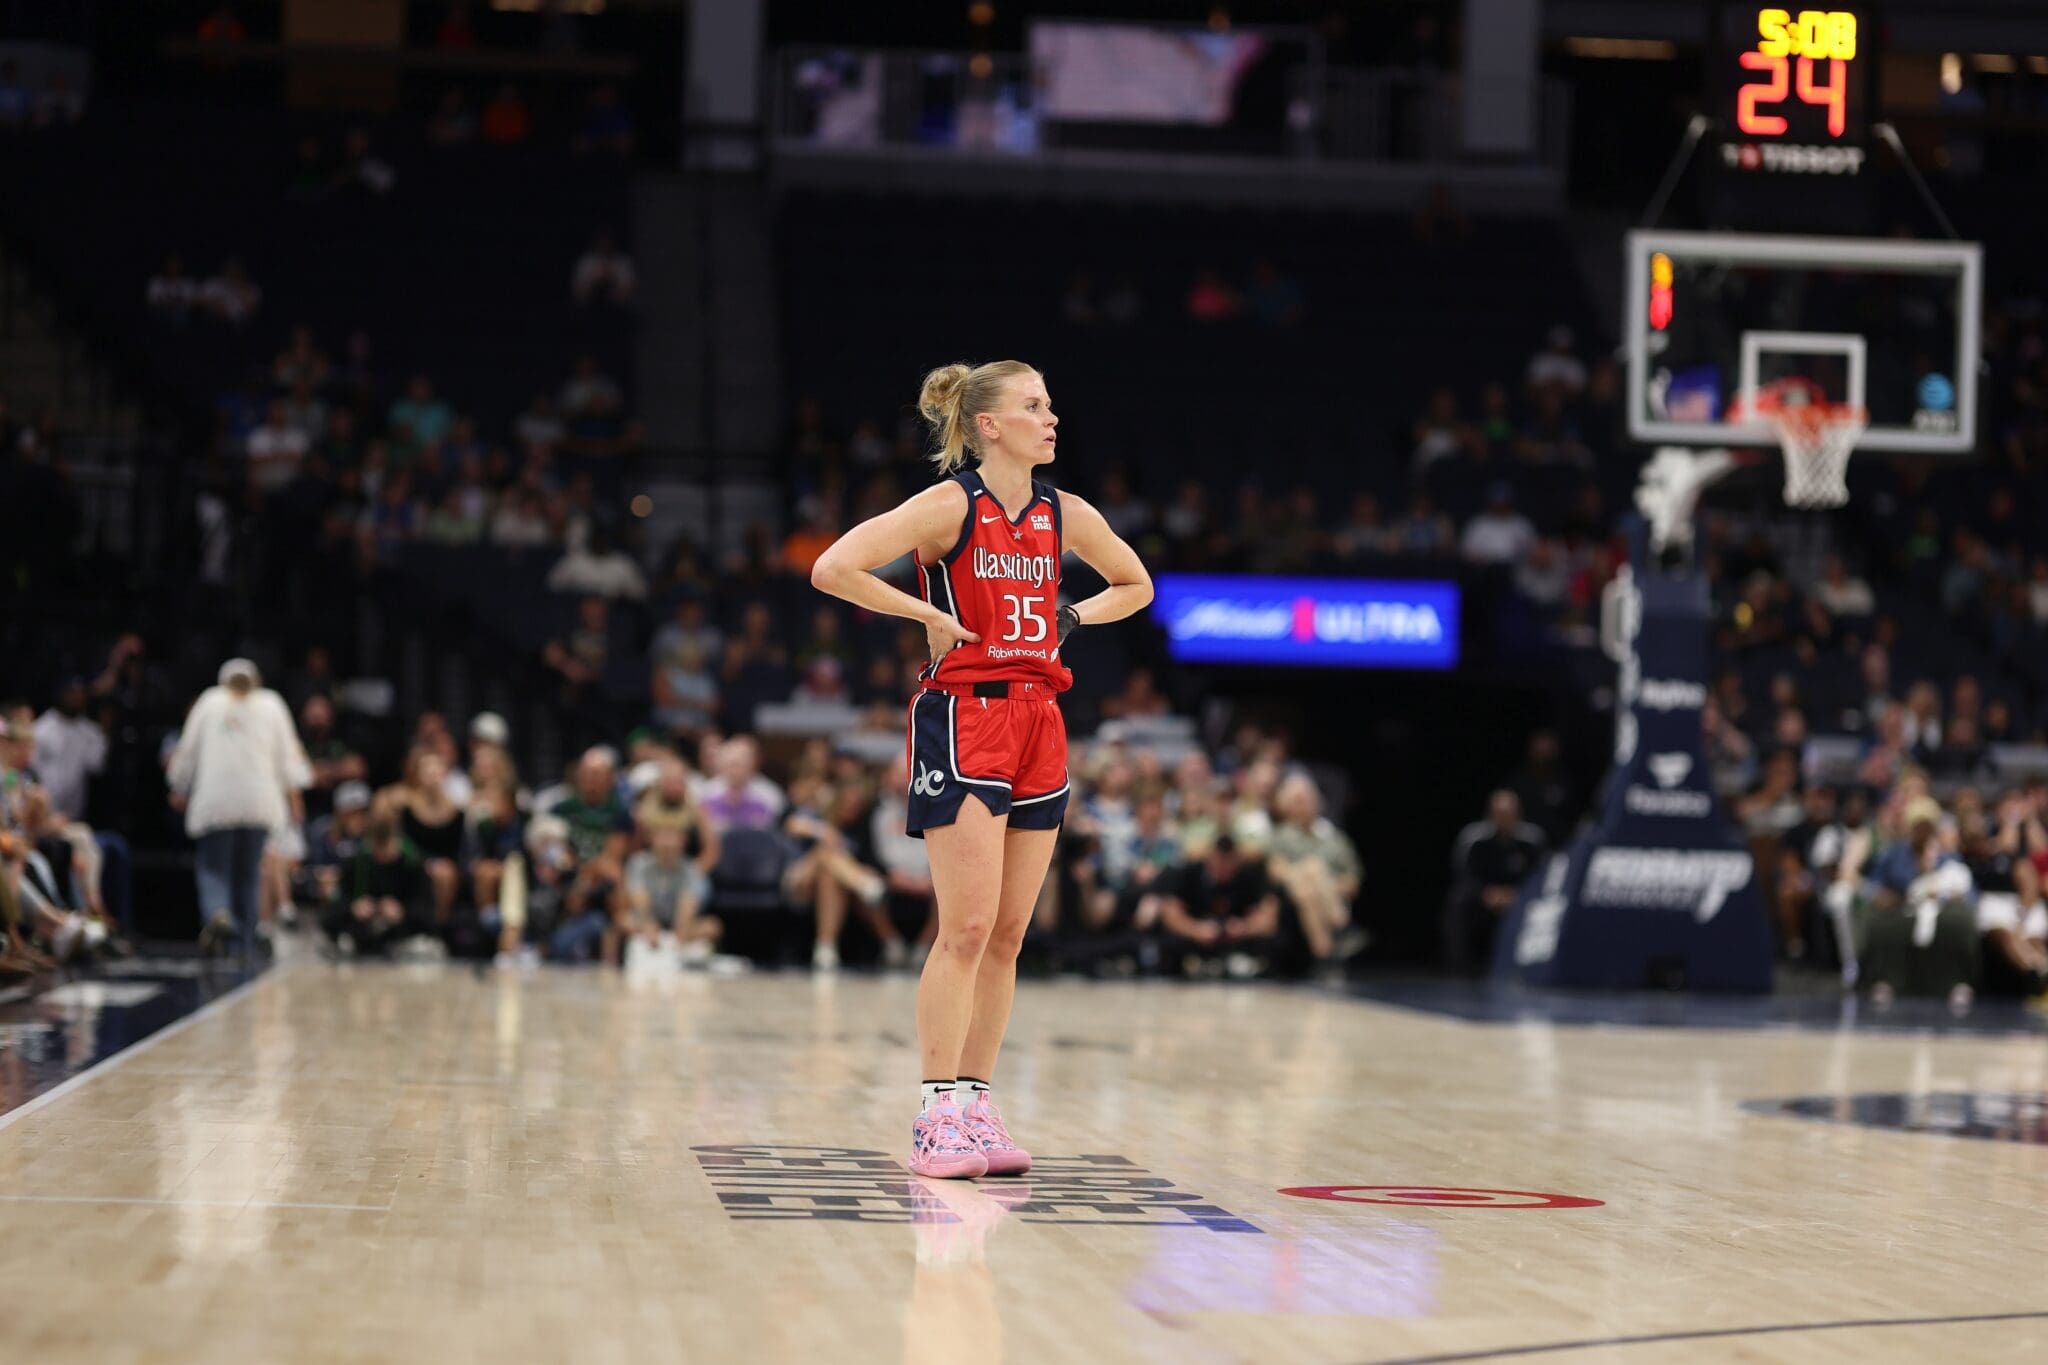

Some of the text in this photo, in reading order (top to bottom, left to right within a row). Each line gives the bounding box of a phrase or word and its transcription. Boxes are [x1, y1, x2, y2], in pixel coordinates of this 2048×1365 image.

[1758, 9, 1857, 60] 5:08
[1737, 52, 1847, 138] 24
[973, 546, 1056, 588] Washingt
[1002, 594, 1047, 642] 35
[1315, 601, 1442, 645] ULTRA
[987, 645, 1046, 659] Robinhood
[688, 1145, 963, 1224] CENTER
